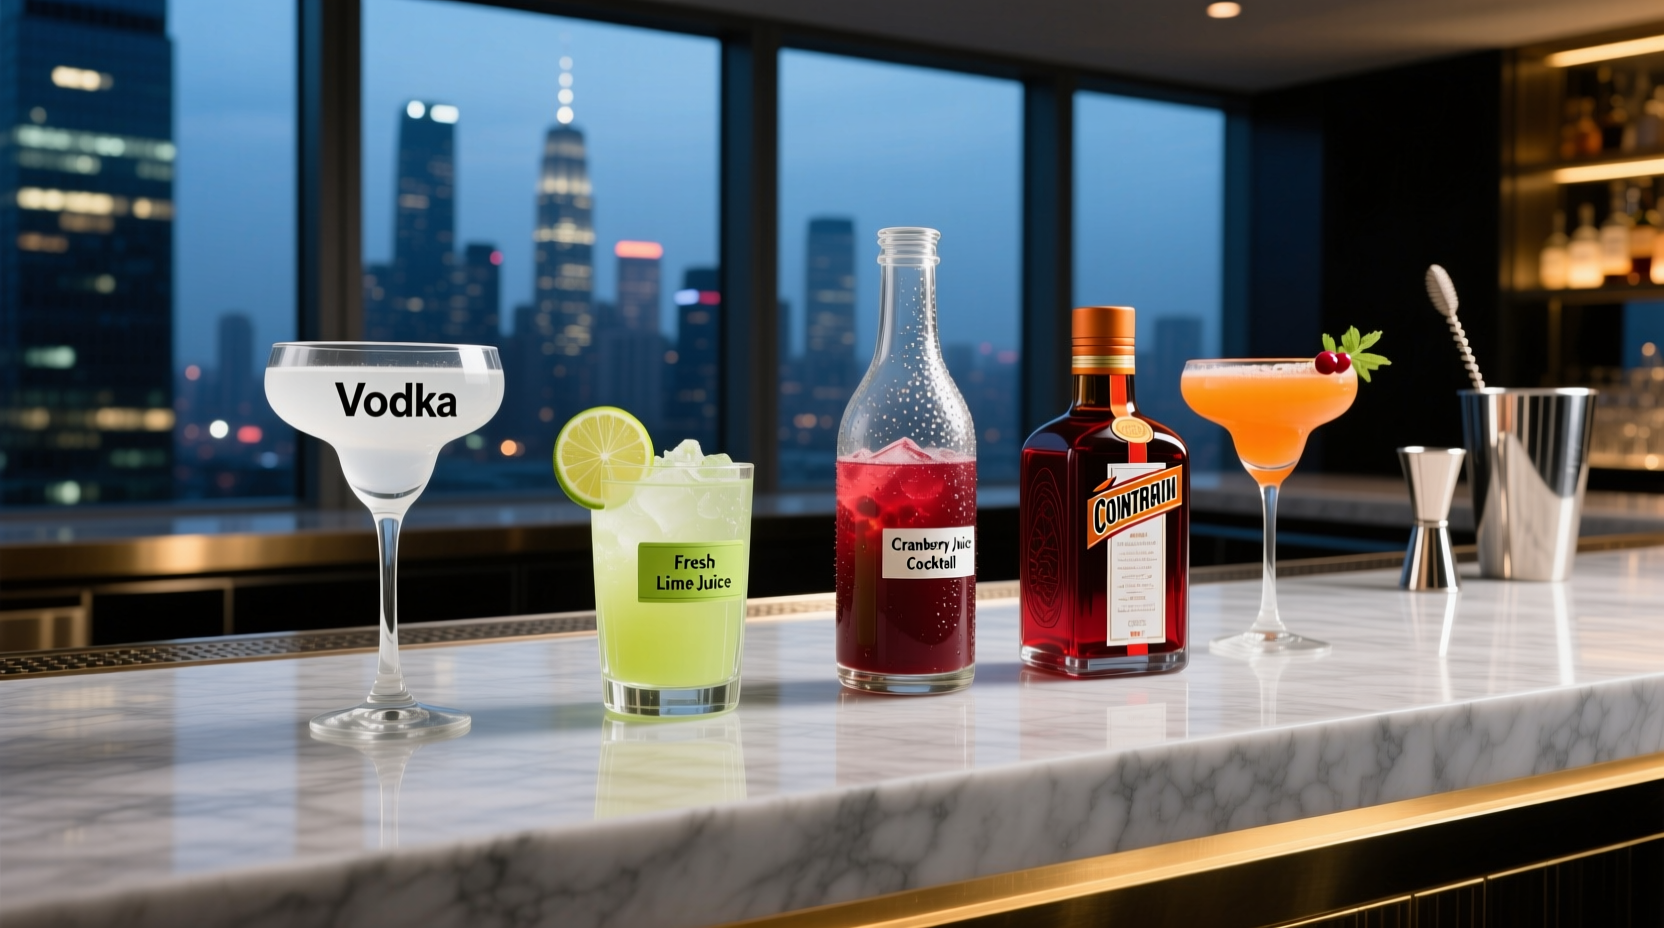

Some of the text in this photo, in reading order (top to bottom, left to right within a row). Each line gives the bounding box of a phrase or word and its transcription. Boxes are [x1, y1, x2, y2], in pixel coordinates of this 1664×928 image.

[335, 382, 457, 417] Vodka
[675, 553, 715, 570] Fresh
[656, 574, 732, 591] Lime Juice
